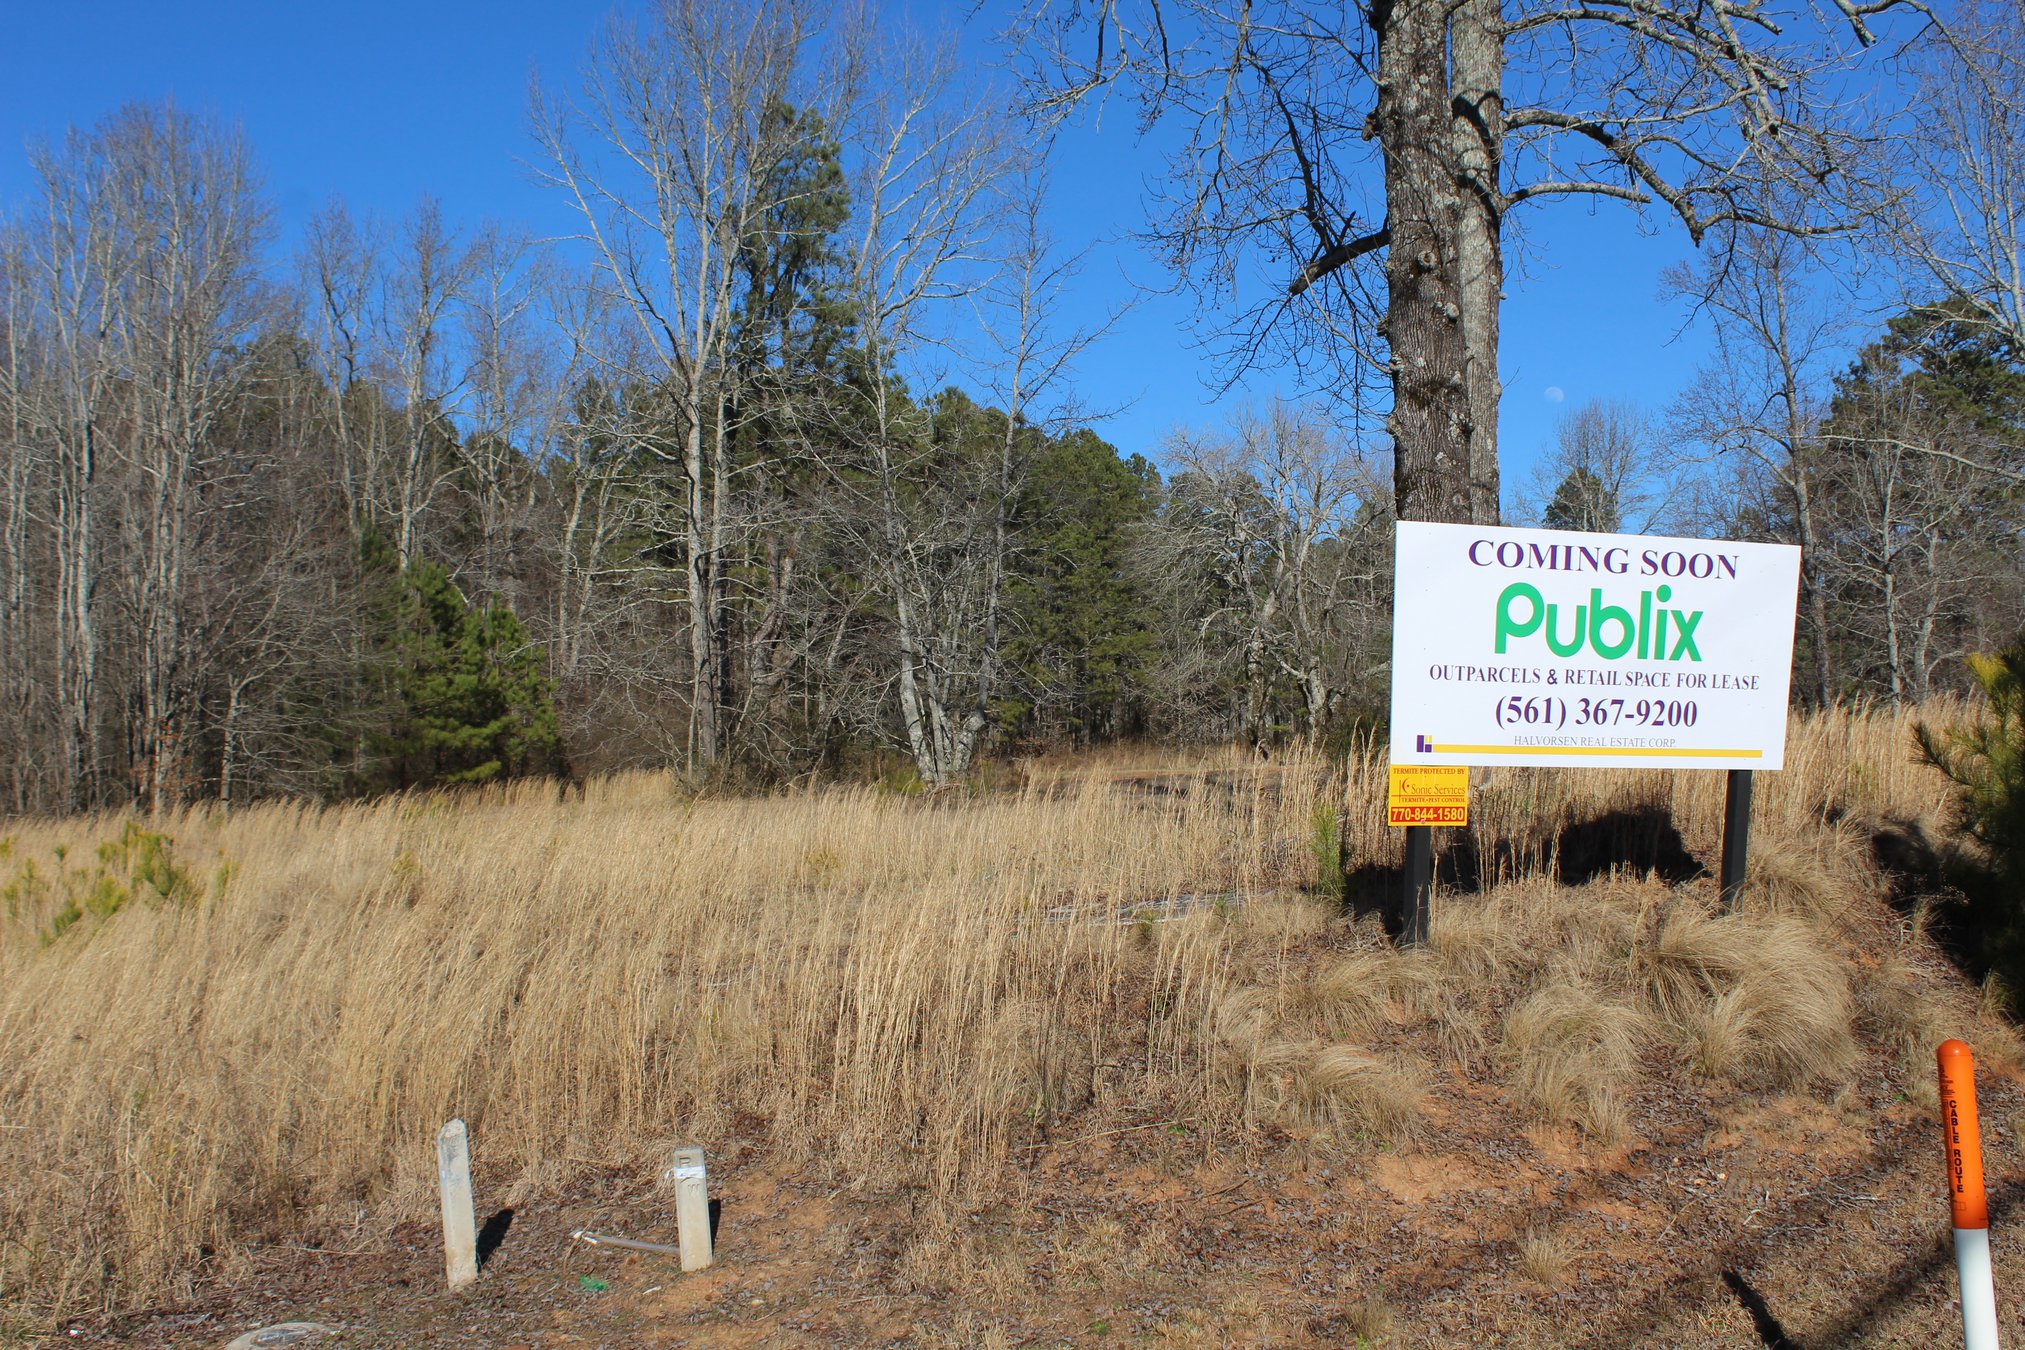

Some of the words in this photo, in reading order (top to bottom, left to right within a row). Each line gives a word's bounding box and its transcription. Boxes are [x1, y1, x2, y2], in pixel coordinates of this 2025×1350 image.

[1468, 540, 1630, 574] COMING
[1640, 549, 1740, 580] SOON
[1494, 582, 1704, 662] Publix
[1429, 664, 1541, 684] OUTPARCELS
[1546, 668, 1558, 685] &
[1564, 668, 1622, 686] RETAIL
[1624, 671, 1671, 688] SPACE
[1676, 672, 1707, 689] FOR
[1712, 674, 1760, 690] LEASE
[1495, 695, 1567, 731] (561)
[1575, 697, 1698, 727] 367-9200
[1514, 735, 1578, 746] HALVORSEN
[1580, 736, 1607, 747] REAL
[1610, 737, 1647, 748] ESTATE
[1411, 783, 1432, 795] Sonic
[1433, 783, 1466, 795] Services
[1392, 808, 1464, 821] 770-844-1580
[1949, 1100, 1960, 1144] CABLE
[1954, 1149, 1964, 1193] ROUTE
